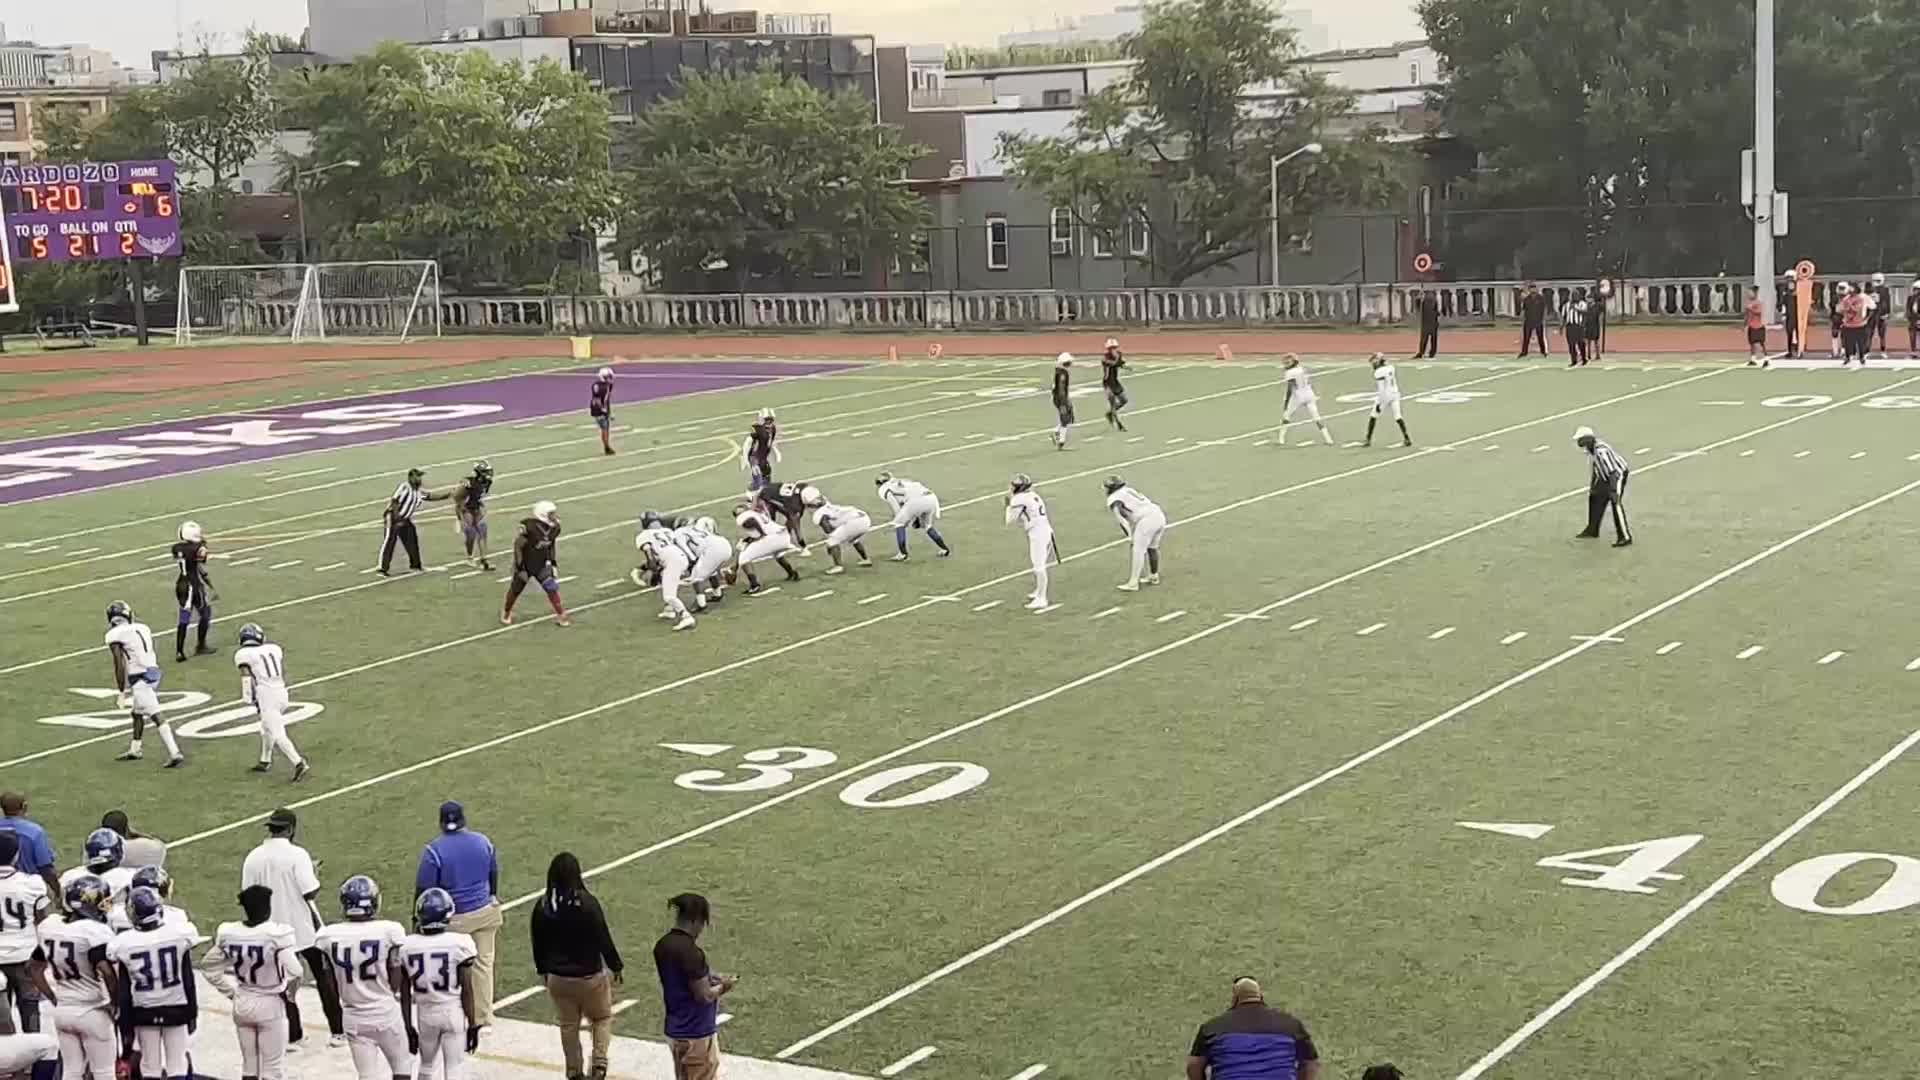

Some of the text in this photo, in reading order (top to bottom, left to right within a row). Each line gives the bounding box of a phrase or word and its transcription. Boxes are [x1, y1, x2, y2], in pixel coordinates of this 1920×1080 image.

[0, 163, 120, 186] ARDOZO
[130, 167, 159, 177] HOME
[22, 185, 81, 211] 7:20
[157, 195, 172, 216] 6
[14, 223, 49, 237] TO GO
[60, 221, 109, 234] BALL ON
[33, 237, 47, 258] 5
[121, 233, 135, 254] 2
[259, 652, 279, 677] 11
[673, 746, 990, 807] 30
[1536, 834, 1920, 915] 40
[129, 945, 181, 992] 30
[331, 939, 380, 984] 42
[407, 952, 449, 992] 23
